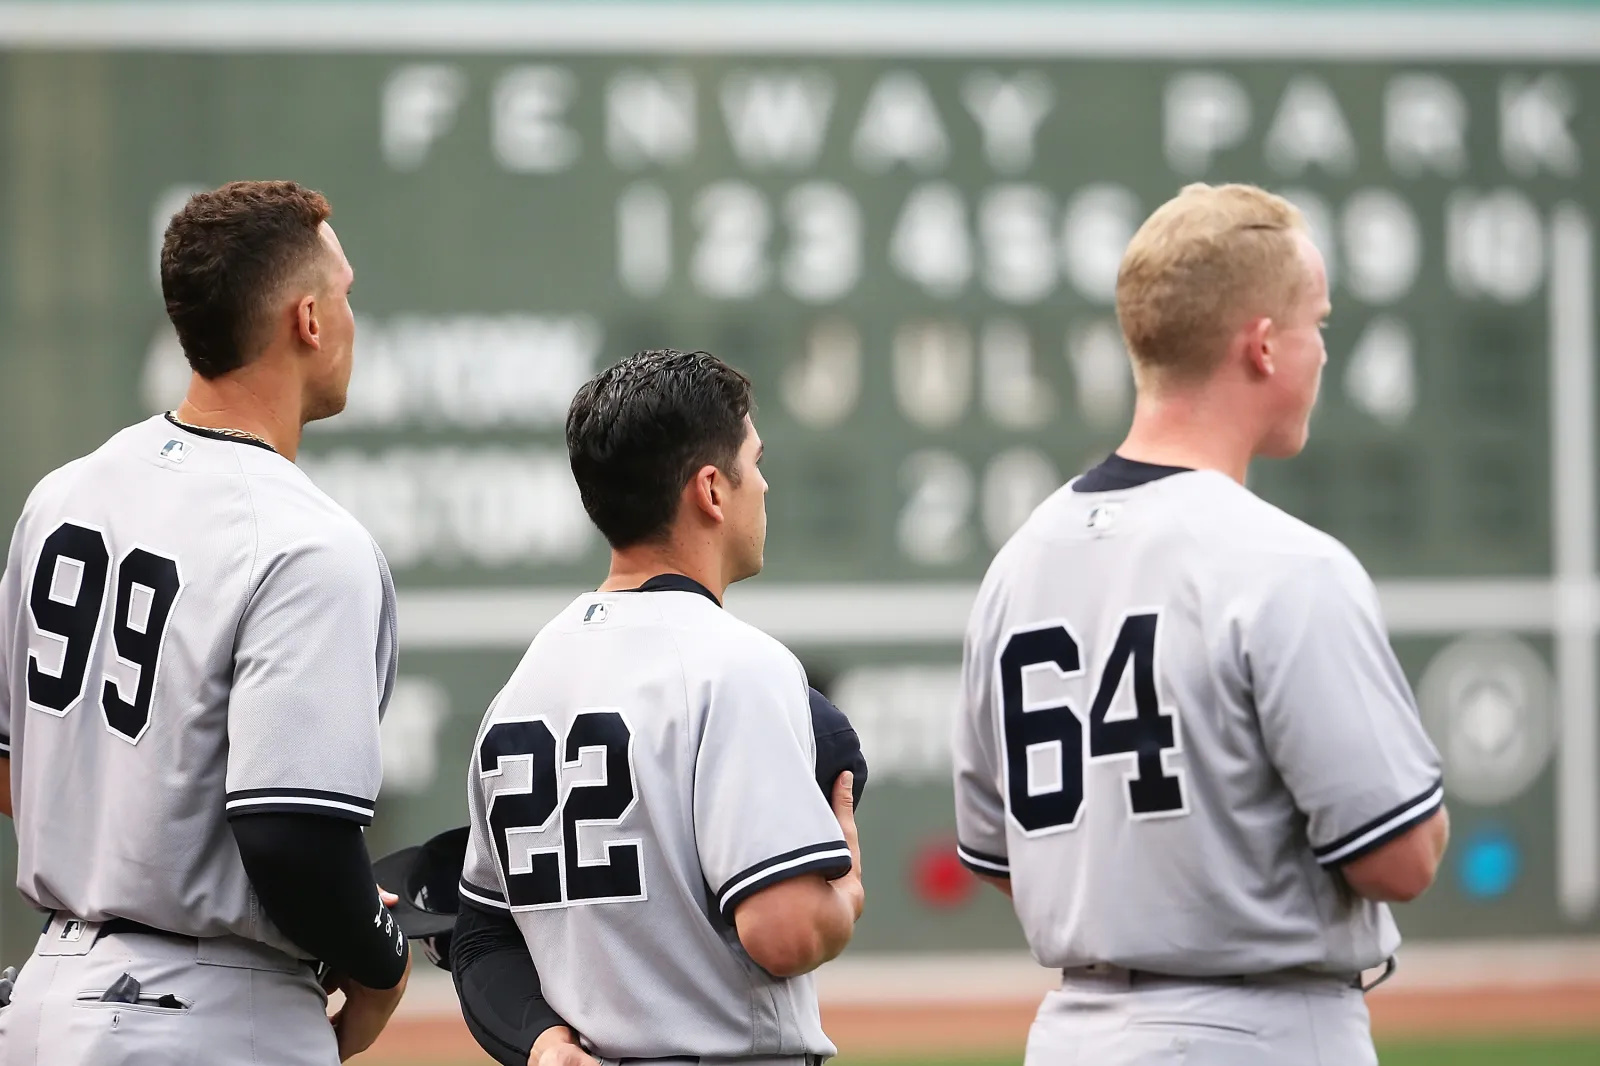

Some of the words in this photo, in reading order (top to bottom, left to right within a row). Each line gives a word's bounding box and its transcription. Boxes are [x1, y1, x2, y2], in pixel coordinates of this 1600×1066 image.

[380, 64, 1052, 172] FENWAY
[1163, 70, 1580, 178] PARK
[26, 520, 186, 746] 99
[1000, 610, 1192, 837] 64
[480, 707, 648, 912] 22
